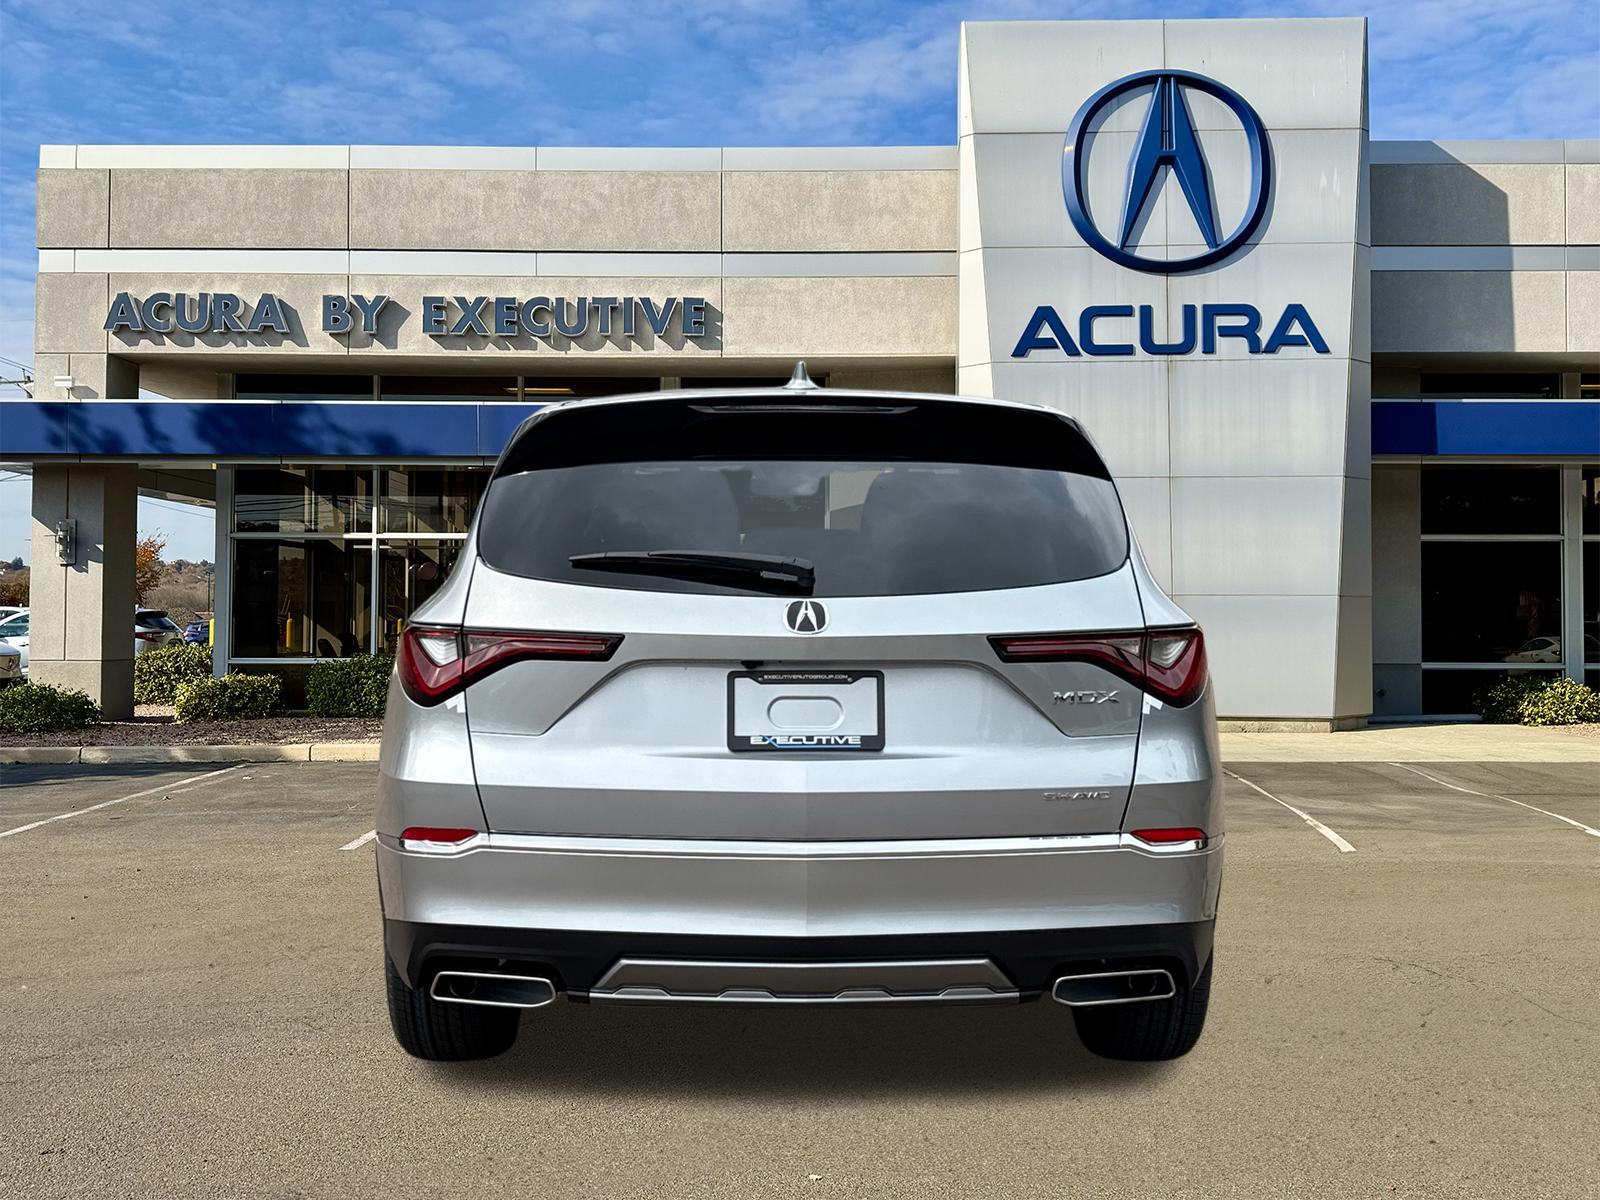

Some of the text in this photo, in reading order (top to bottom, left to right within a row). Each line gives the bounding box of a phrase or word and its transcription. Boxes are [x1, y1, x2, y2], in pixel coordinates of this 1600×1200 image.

[104, 292, 707, 337] ACURA BY EXECUTIVE
[1011, 304, 1332, 357] ACURA
[1053, 690, 1120, 705] MDX
[750, 735, 861, 745] EXECUTIVE
